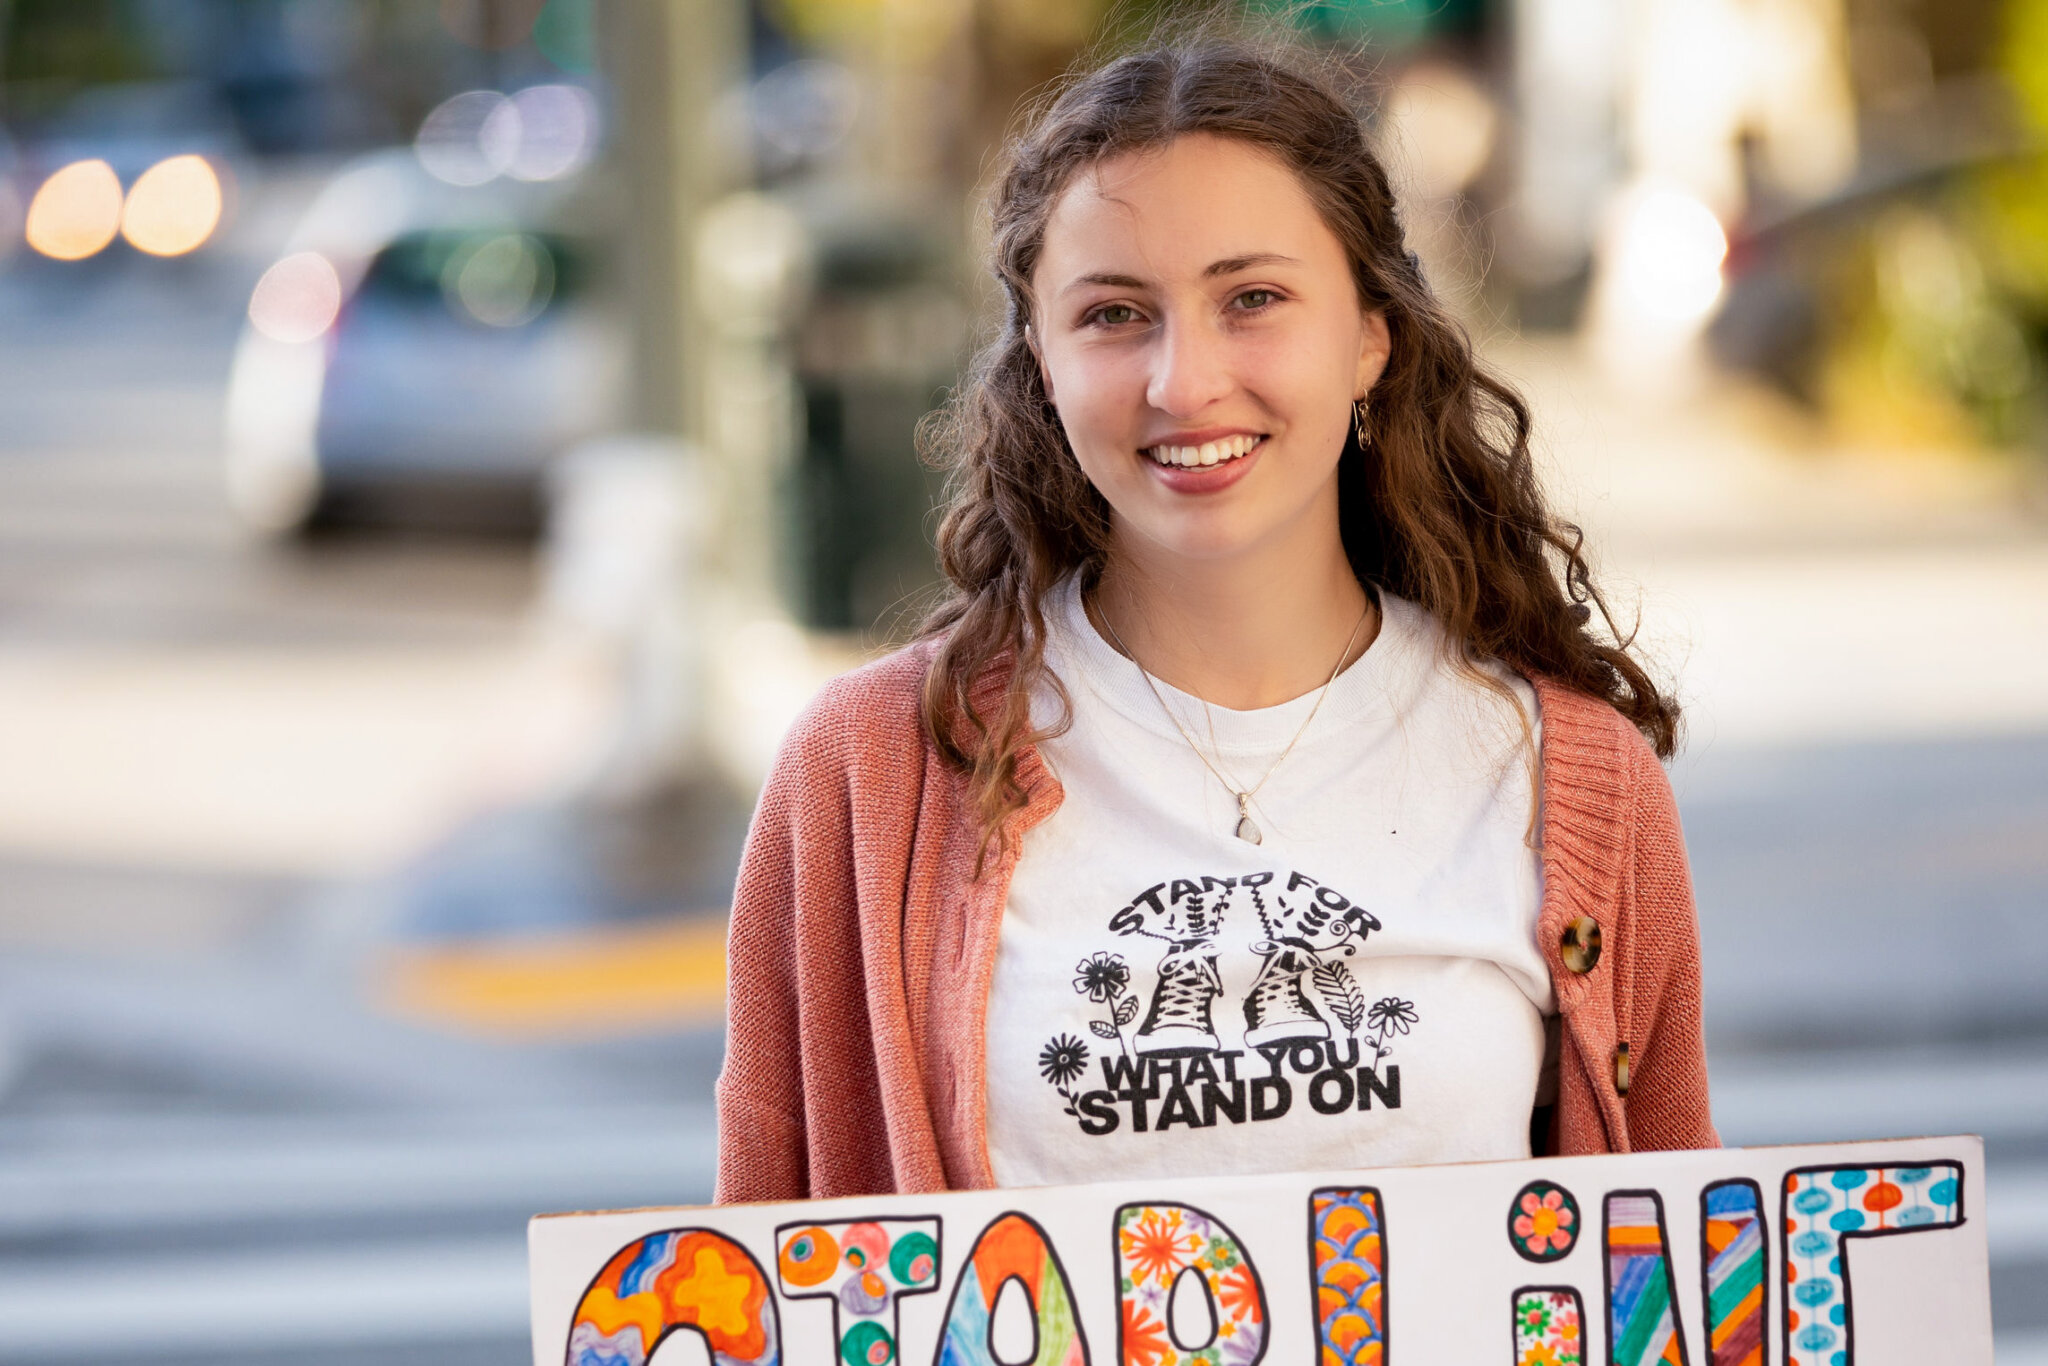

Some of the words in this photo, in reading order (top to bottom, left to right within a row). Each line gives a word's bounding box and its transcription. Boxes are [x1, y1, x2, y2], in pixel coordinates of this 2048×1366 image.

[1108, 872, 1274, 936] STAND
[1287, 870, 1382, 941] FOR
[1100, 1049, 1245, 1091] WHAT
[1257, 1037, 1360, 1079] YOU
[1078, 1075, 1293, 1136] STAND
[1308, 1065, 1402, 1115] ON
